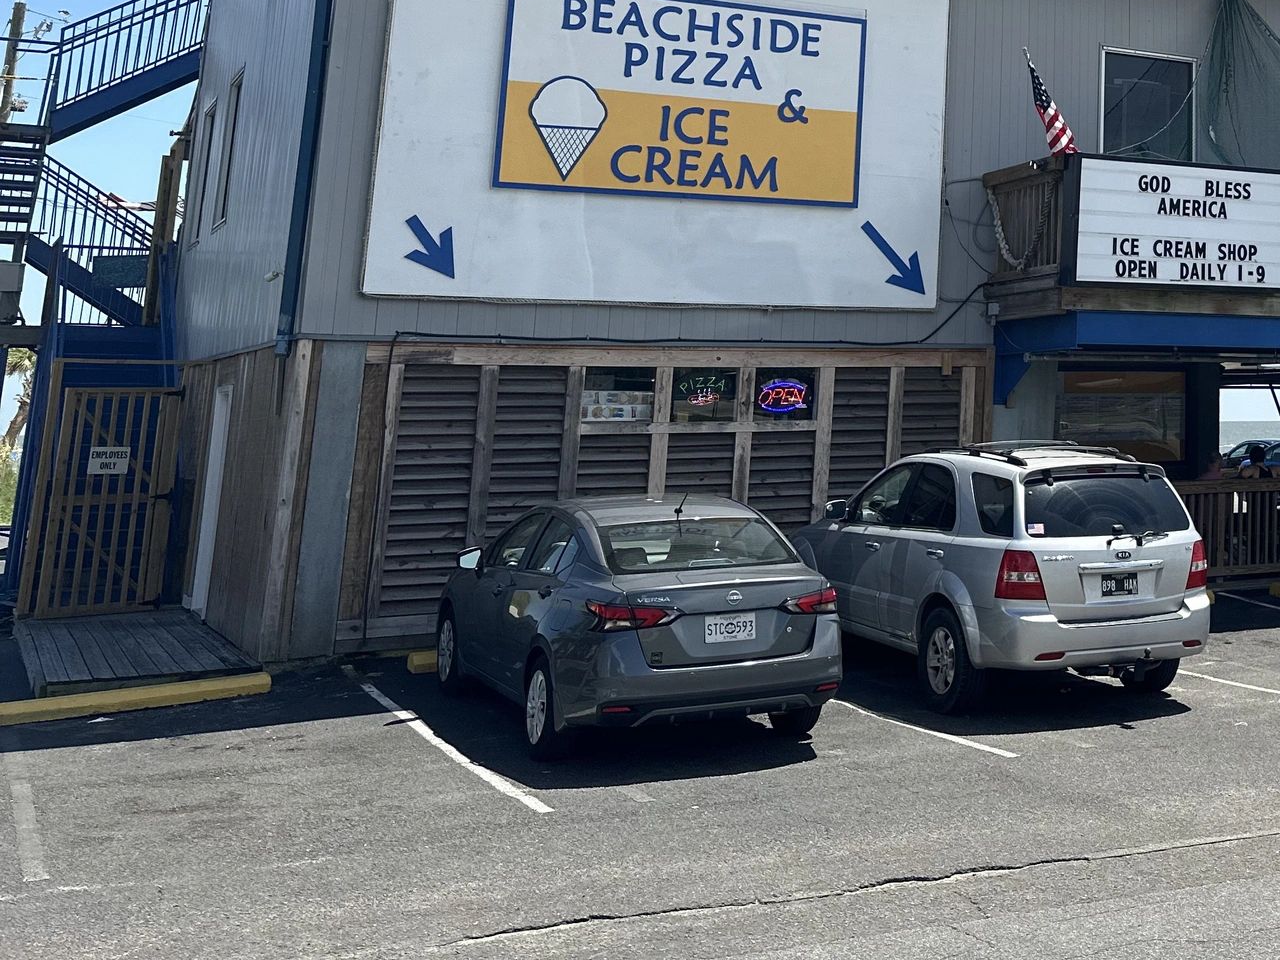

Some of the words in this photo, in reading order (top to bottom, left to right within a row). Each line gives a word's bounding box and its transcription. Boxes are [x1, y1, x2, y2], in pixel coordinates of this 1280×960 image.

[623, 41, 763, 91] PIZZA
[777, 88, 809, 124] &
[659, 104, 731, 146] ICE
[610, 144, 779, 192] CREAM
[1138, 175, 1171, 193] GOD
[1205, 180, 1251, 200] BLESS
[1157, 198, 1228, 219] AMERICA
[1112, 237, 1140, 256] ICE
[1153, 239, 1207, 259] CREAM
[1217, 243, 1258, 261] SHOP
[1115, 260, 1158, 279] OPEN
[1180, 263, 1227, 281] DAILY
[679, 376, 726, 394] PIZZA
[758, 387, 806, 406] OPEN
[91, 451, 128, 459] EMPLOYEES
[1102, 580, 1116, 592] 898
[636, 595, 671, 604] VERSA
[736, 620, 754, 634] 593
